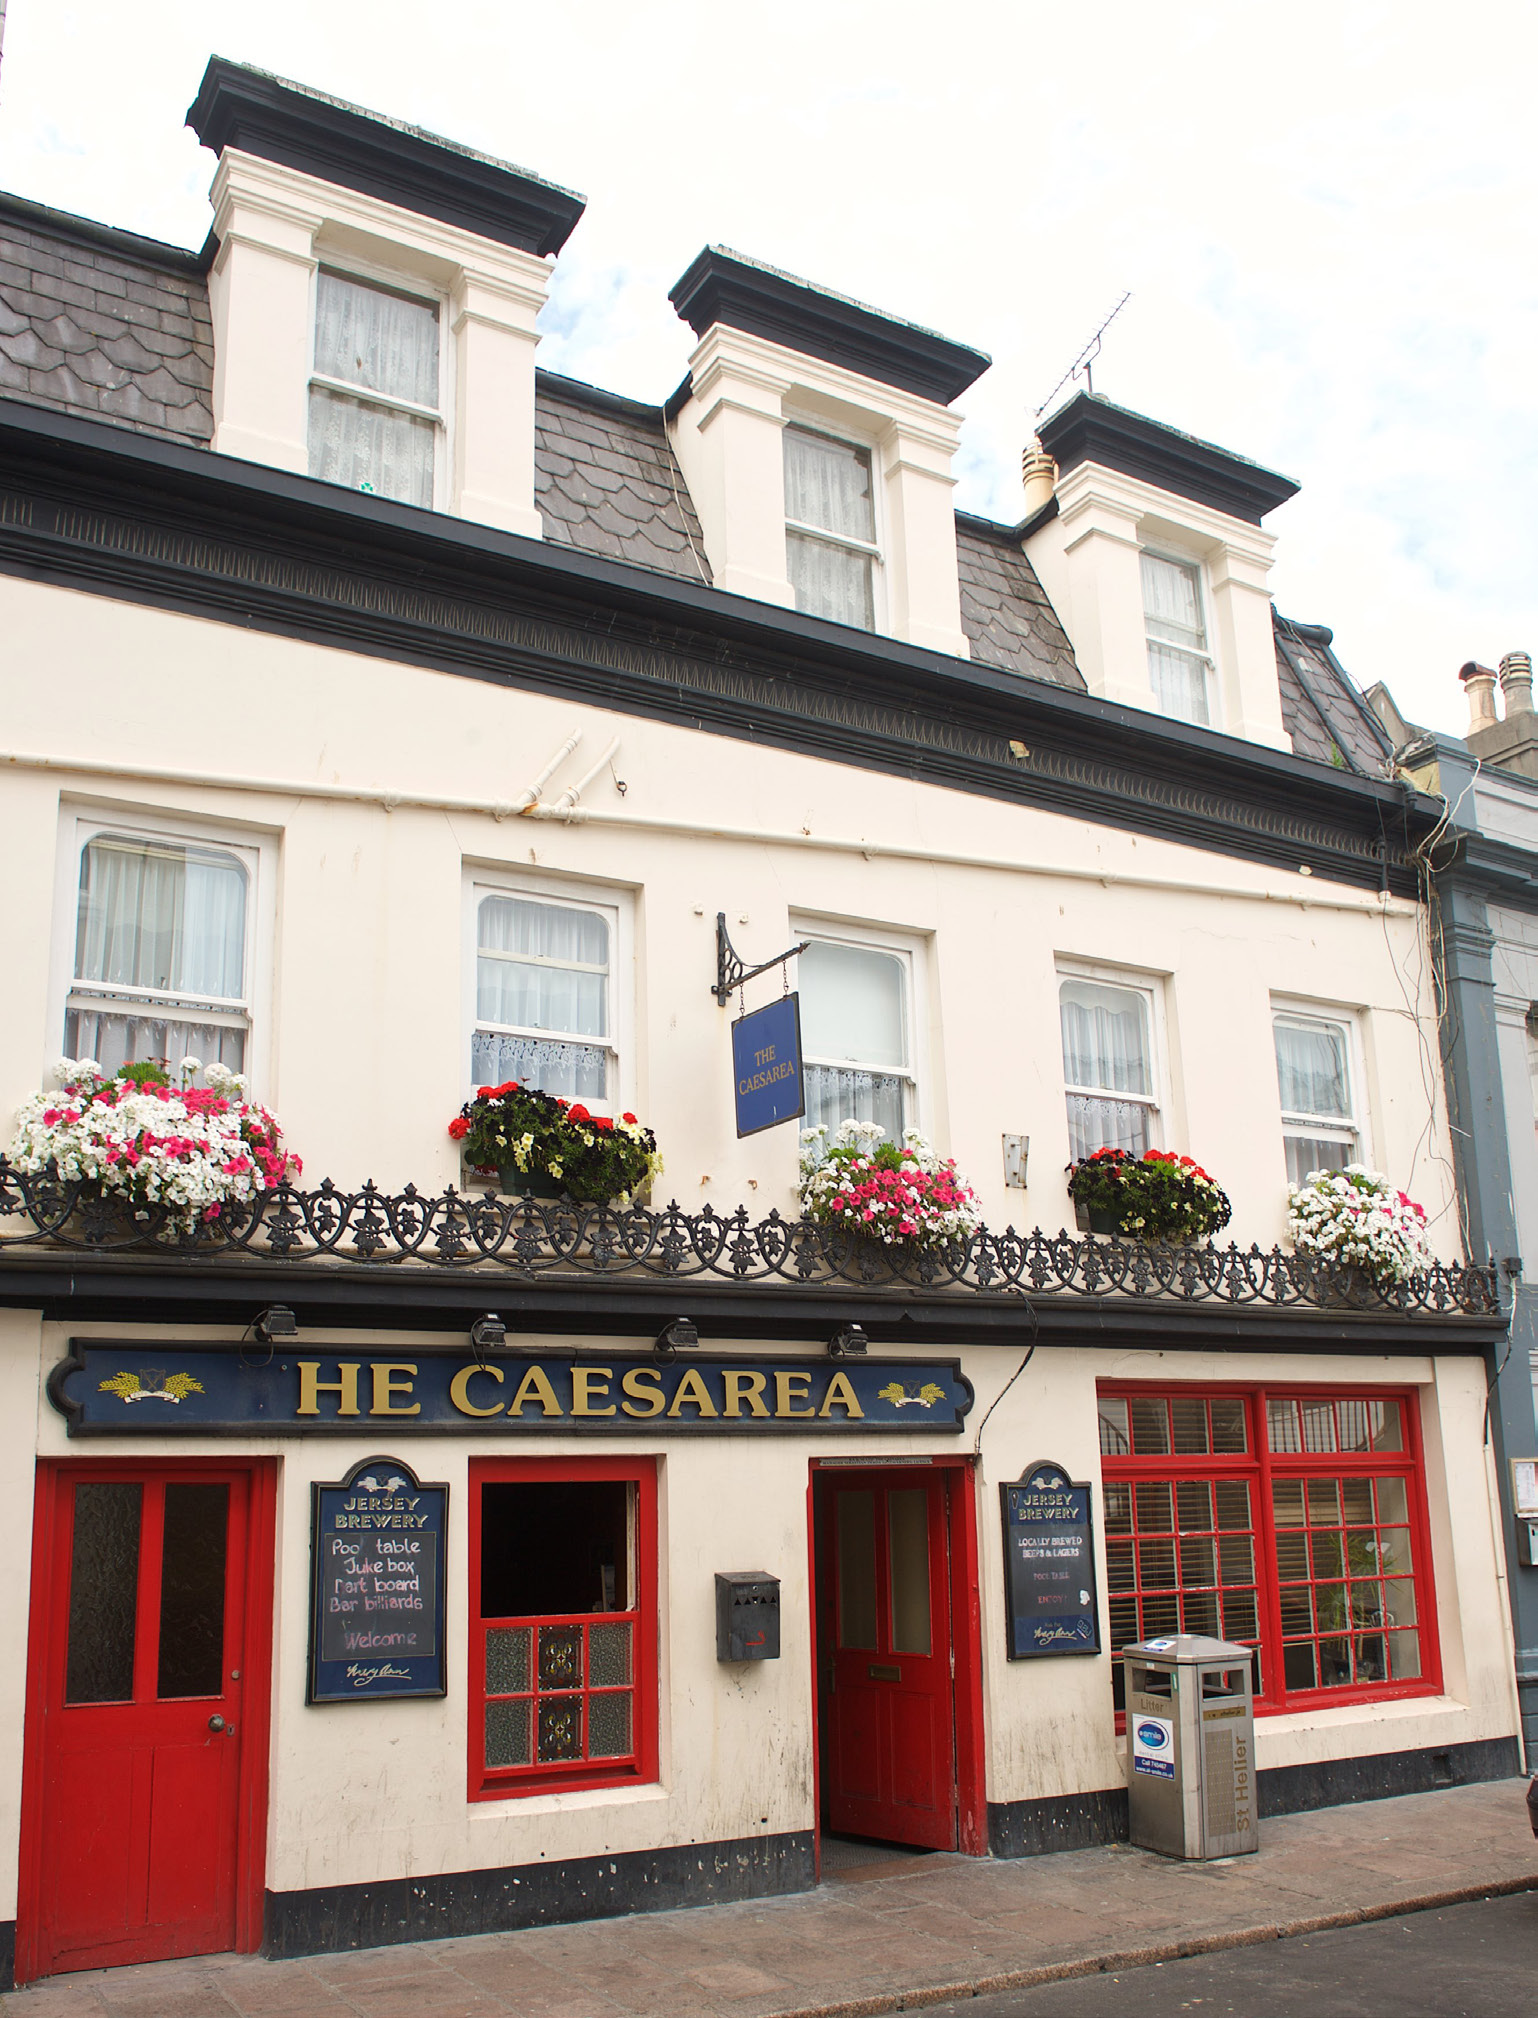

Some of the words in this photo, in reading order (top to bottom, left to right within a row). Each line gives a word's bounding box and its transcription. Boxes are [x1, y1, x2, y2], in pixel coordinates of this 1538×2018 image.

[754, 1045, 776, 1067] THE
[739, 1060, 795, 1095] CAESAREA
[297, 1361, 421, 1415] HE
[450, 1364, 865, 1417] CAESAREA
[343, 1497, 420, 1511] JERSEY
[1023, 1494, 1073, 1506] JERSEY
[335, 1514, 429, 1529] BREWERY
[1018, 1507, 1079, 1520] BREWERY
[332, 1538, 361, 1555] Poo
[376, 1538, 420, 1554] table
[1051, 1536, 1083, 1547] BREWED
[1053, 1548, 1080, 1558] LAGERS
[344, 1557, 383, 1574] Juke
[387, 1557, 415, 1576] box
[374, 1574, 419, 1592] board
[330, 1597, 358, 1612] Bar
[344, 1631, 417, 1650] Welcome
[1140, 1699, 1165, 1712] Litter
[1234, 1736, 1249, 1801] Helier
[1237, 1808, 1249, 1833] St
